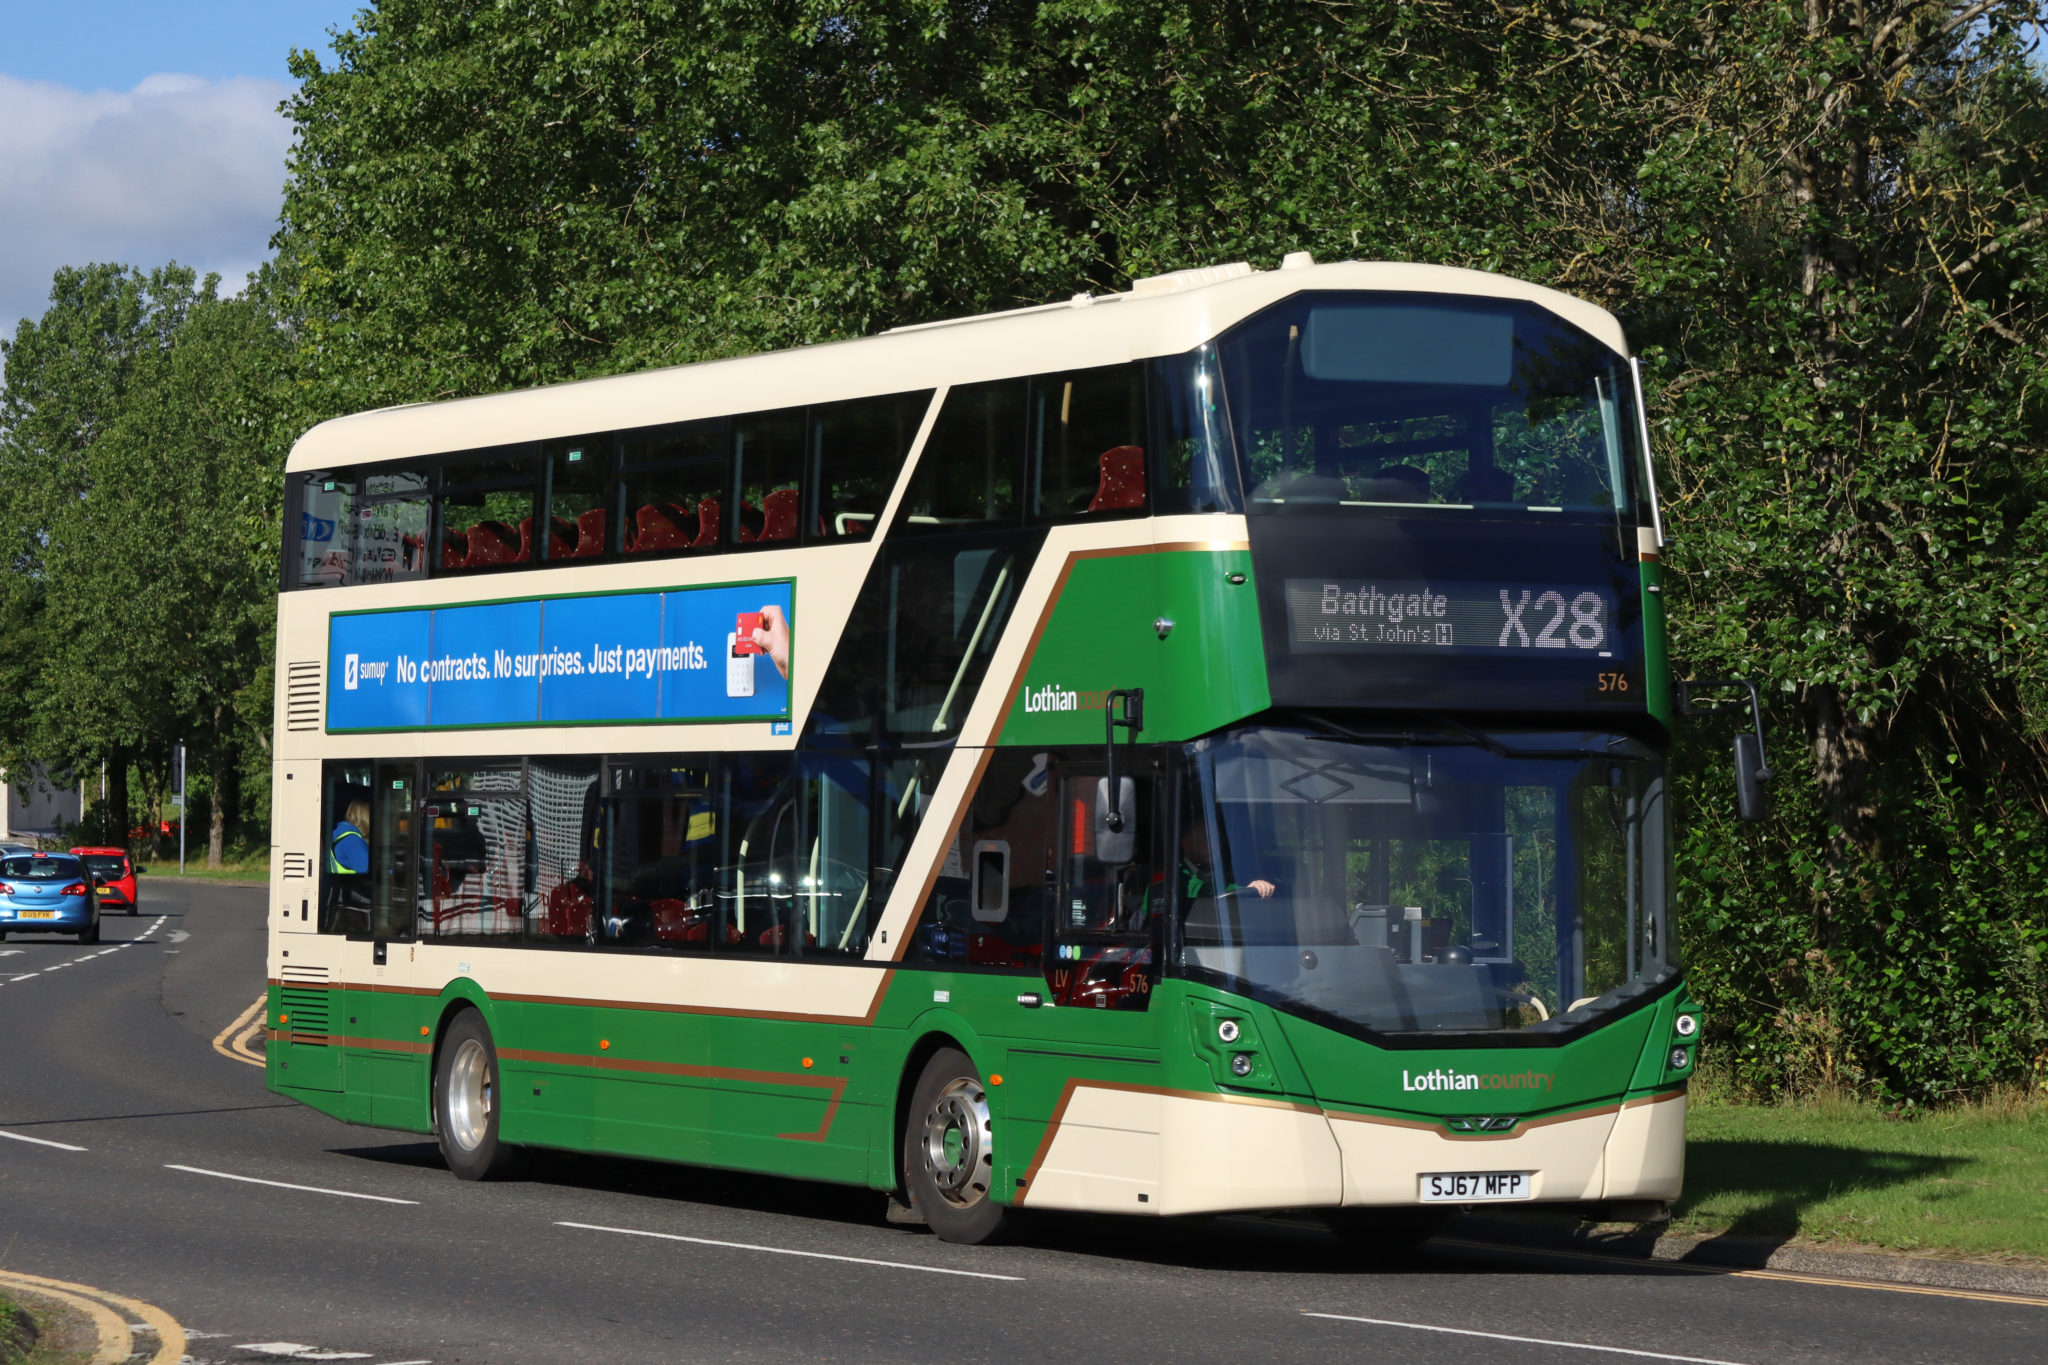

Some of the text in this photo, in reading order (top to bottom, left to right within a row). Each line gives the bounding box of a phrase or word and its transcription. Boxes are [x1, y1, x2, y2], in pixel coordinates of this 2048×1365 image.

[1321, 584, 1448, 622] Bathgate
[1498, 589, 1604, 649] X28
[1314, 623, 1340, 641] via
[1349, 623, 1369, 641] St
[1376, 624, 1431, 643] John's
[397, 655, 417, 683] No
[420, 652, 491, 683] contracts.
[494, 649, 512, 679] No
[514, 646, 585, 684] surprises.
[588, 643, 623, 674] Just
[625, 640, 708, 680] payments.
[1598, 672, 1629, 692] 576
[1055, 968, 1069, 988] LV
[1129, 974, 1149, 994] 576
[1402, 1069, 1555, 1093] Lothiancountry
[1431, 1174, 1522, 1197] SJ67 MFP
